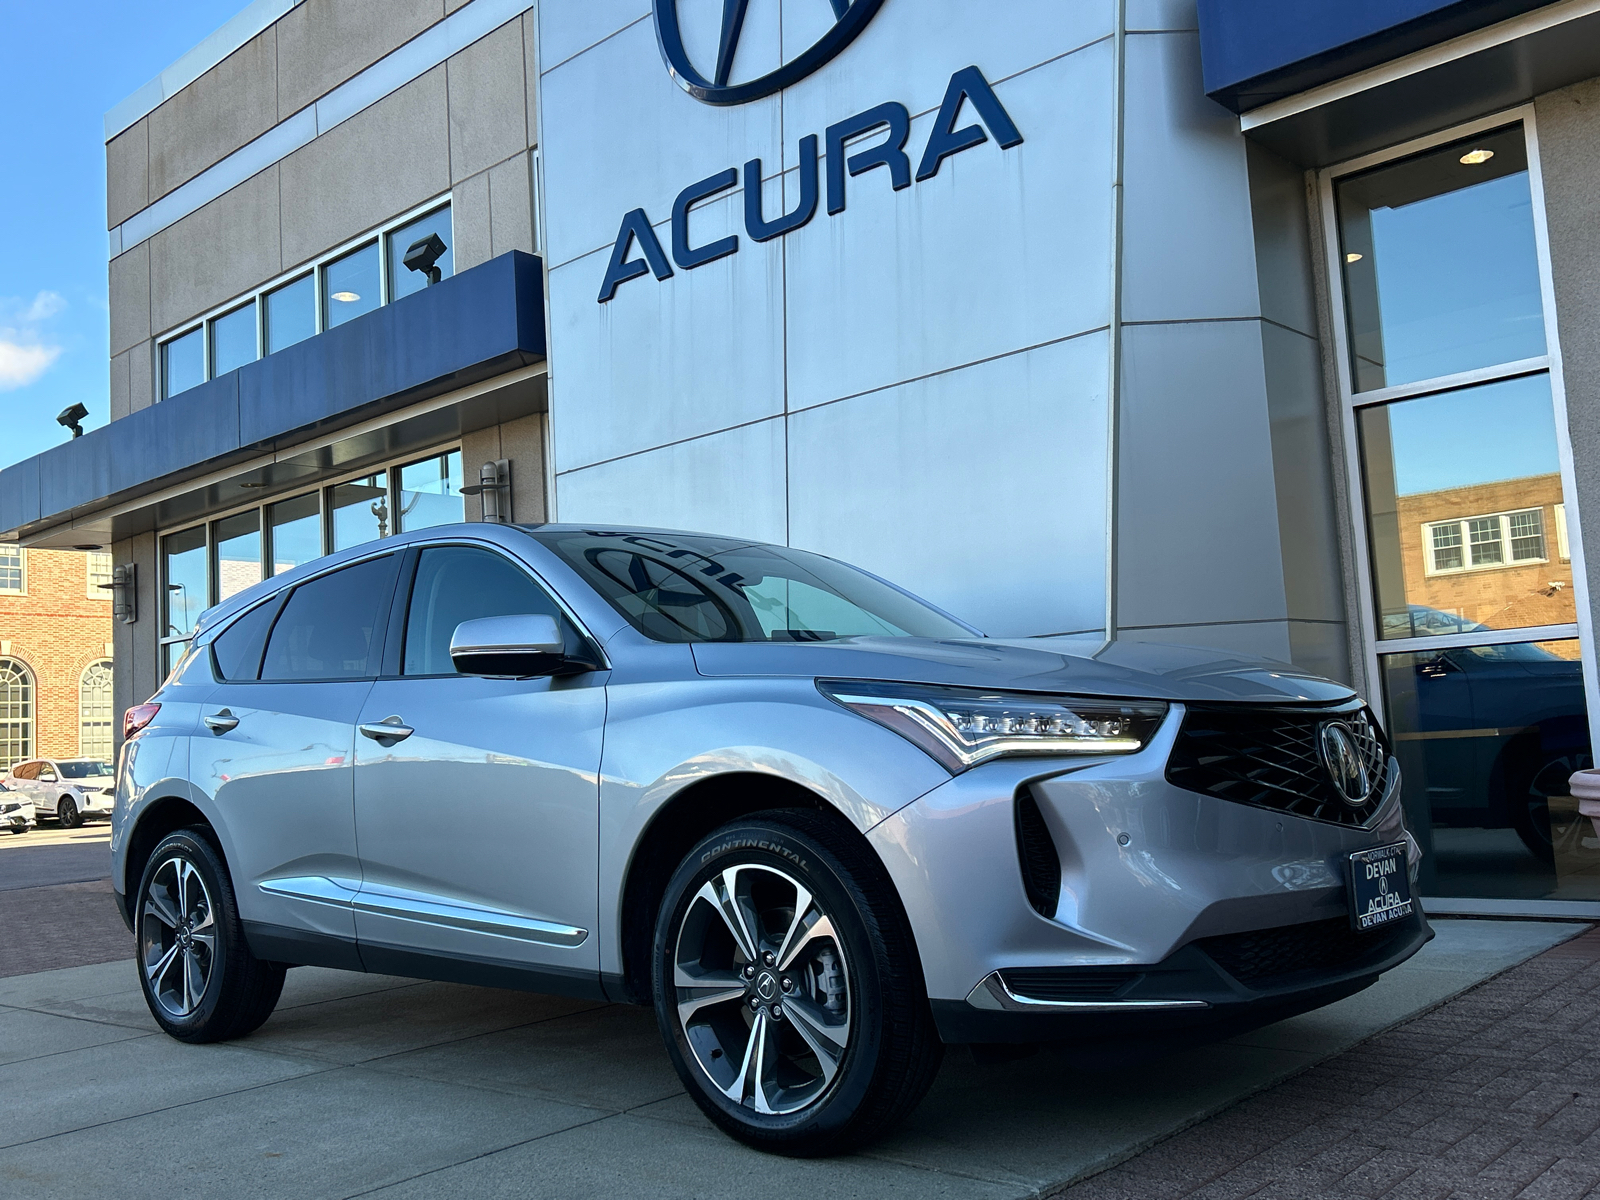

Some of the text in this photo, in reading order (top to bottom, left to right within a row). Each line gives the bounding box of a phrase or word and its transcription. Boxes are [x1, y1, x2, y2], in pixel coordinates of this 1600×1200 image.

[597, 64, 1024, 304] ACURA
[701, 839, 810, 872] CONTINENTAL
[1366, 858, 1397, 880] DEVAN
[1368, 891, 1401, 914] ACURA
[1361, 911, 1387, 927] DEVAN
